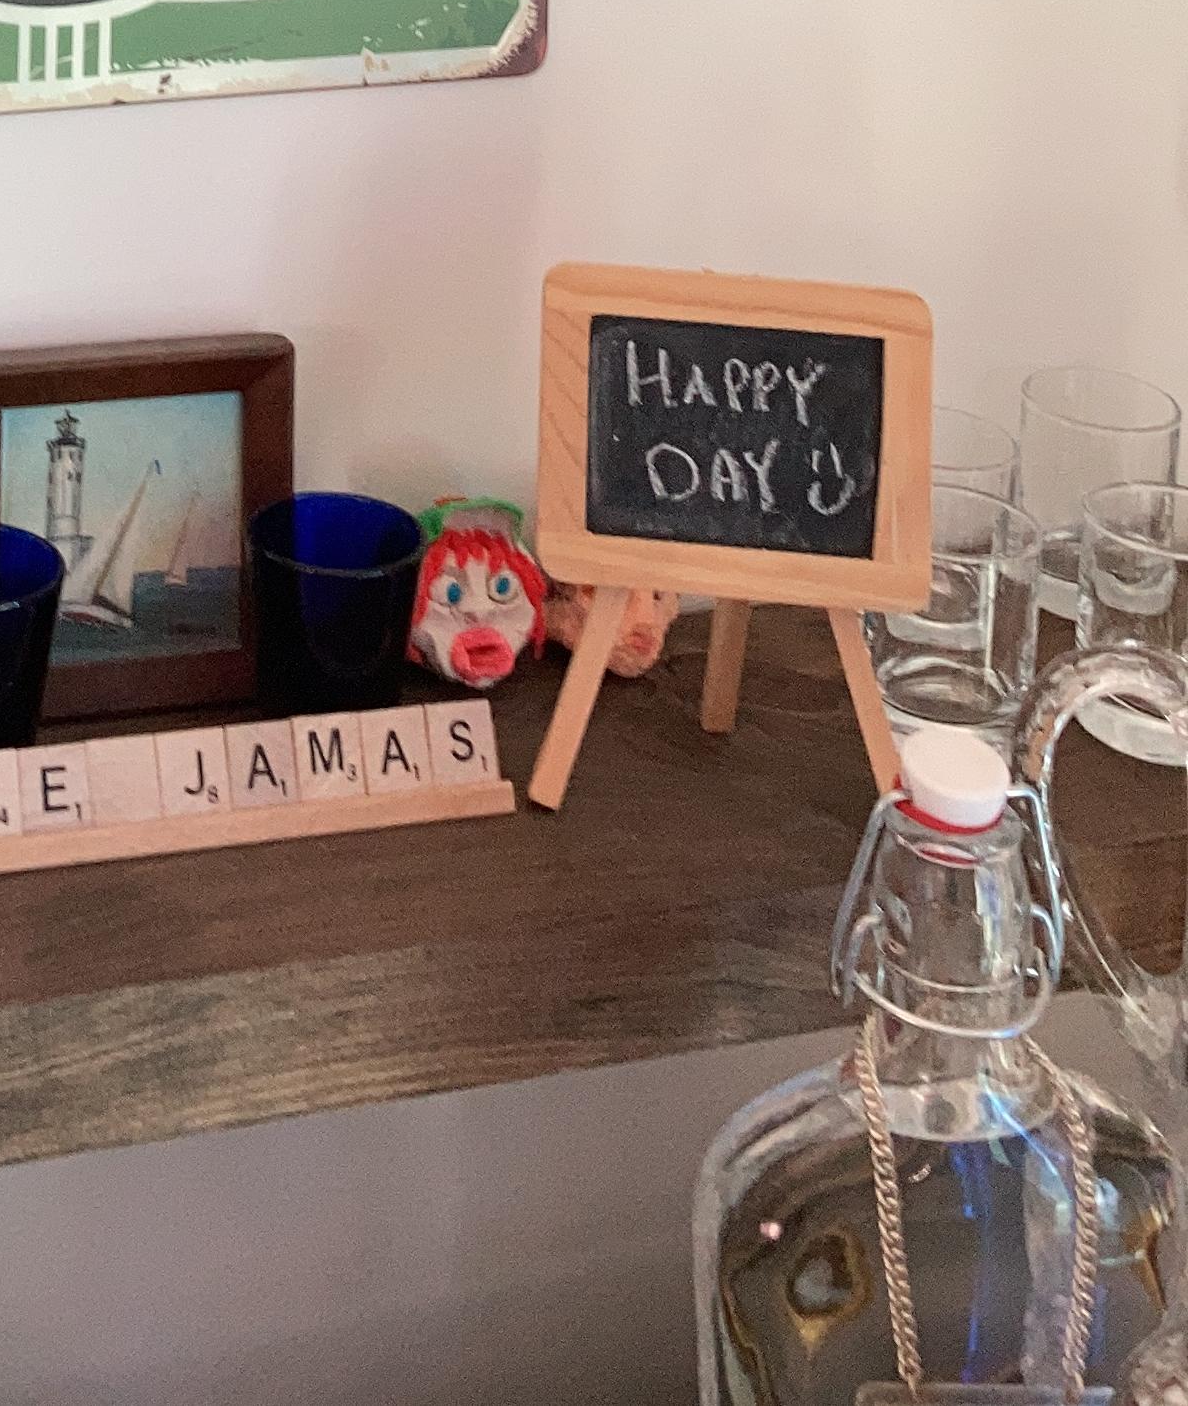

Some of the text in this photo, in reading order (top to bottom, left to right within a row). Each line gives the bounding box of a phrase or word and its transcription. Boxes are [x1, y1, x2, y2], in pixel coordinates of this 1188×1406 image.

[625, 339, 826, 428] HAPPY
[644, 438, 781, 514] DAY
[183, 719, 475, 796] JAMAS
